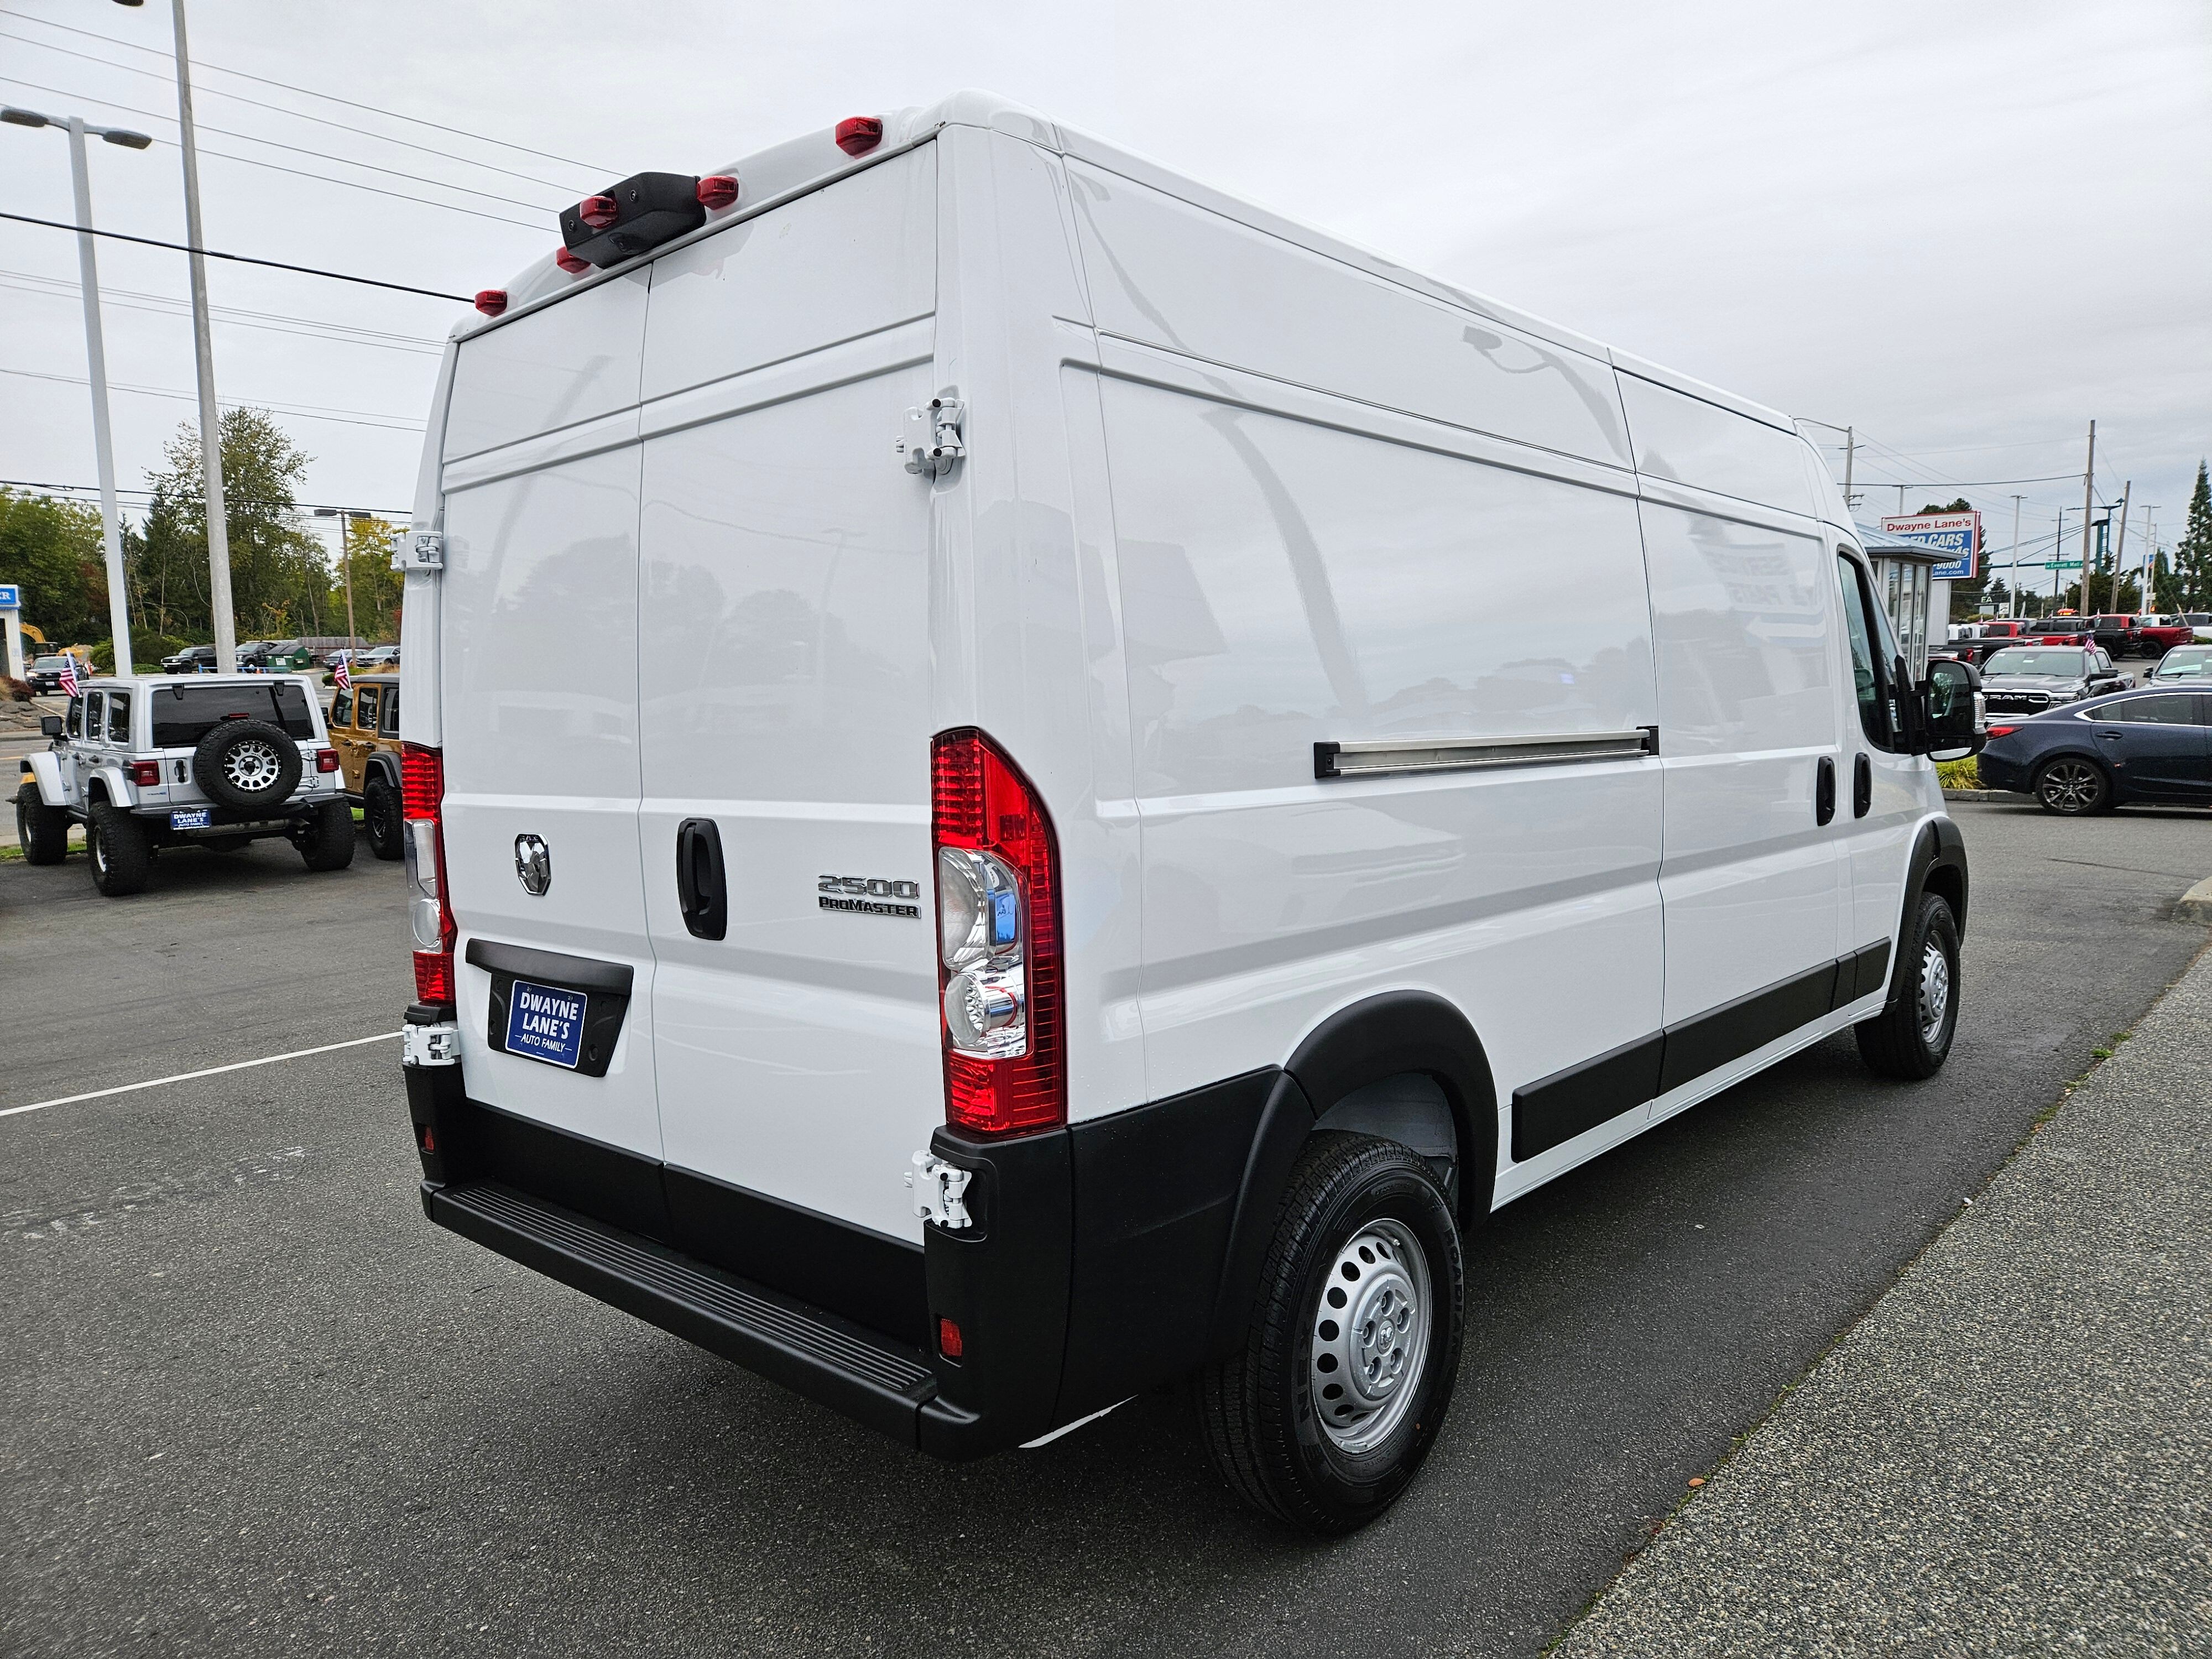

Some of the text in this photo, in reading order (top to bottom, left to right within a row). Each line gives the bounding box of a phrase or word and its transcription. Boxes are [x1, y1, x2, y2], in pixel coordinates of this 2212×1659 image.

[1887, 518, 1971, 532] Dwayne Lane's
[1928, 533, 1964, 547] CARS
[818, 874, 920, 899] 2500
[520, 992, 579, 1021] DWAYNE
[522, 1013, 570, 1040] LANE'S
[520, 1034, 566, 1053] AUTO FAMILY
